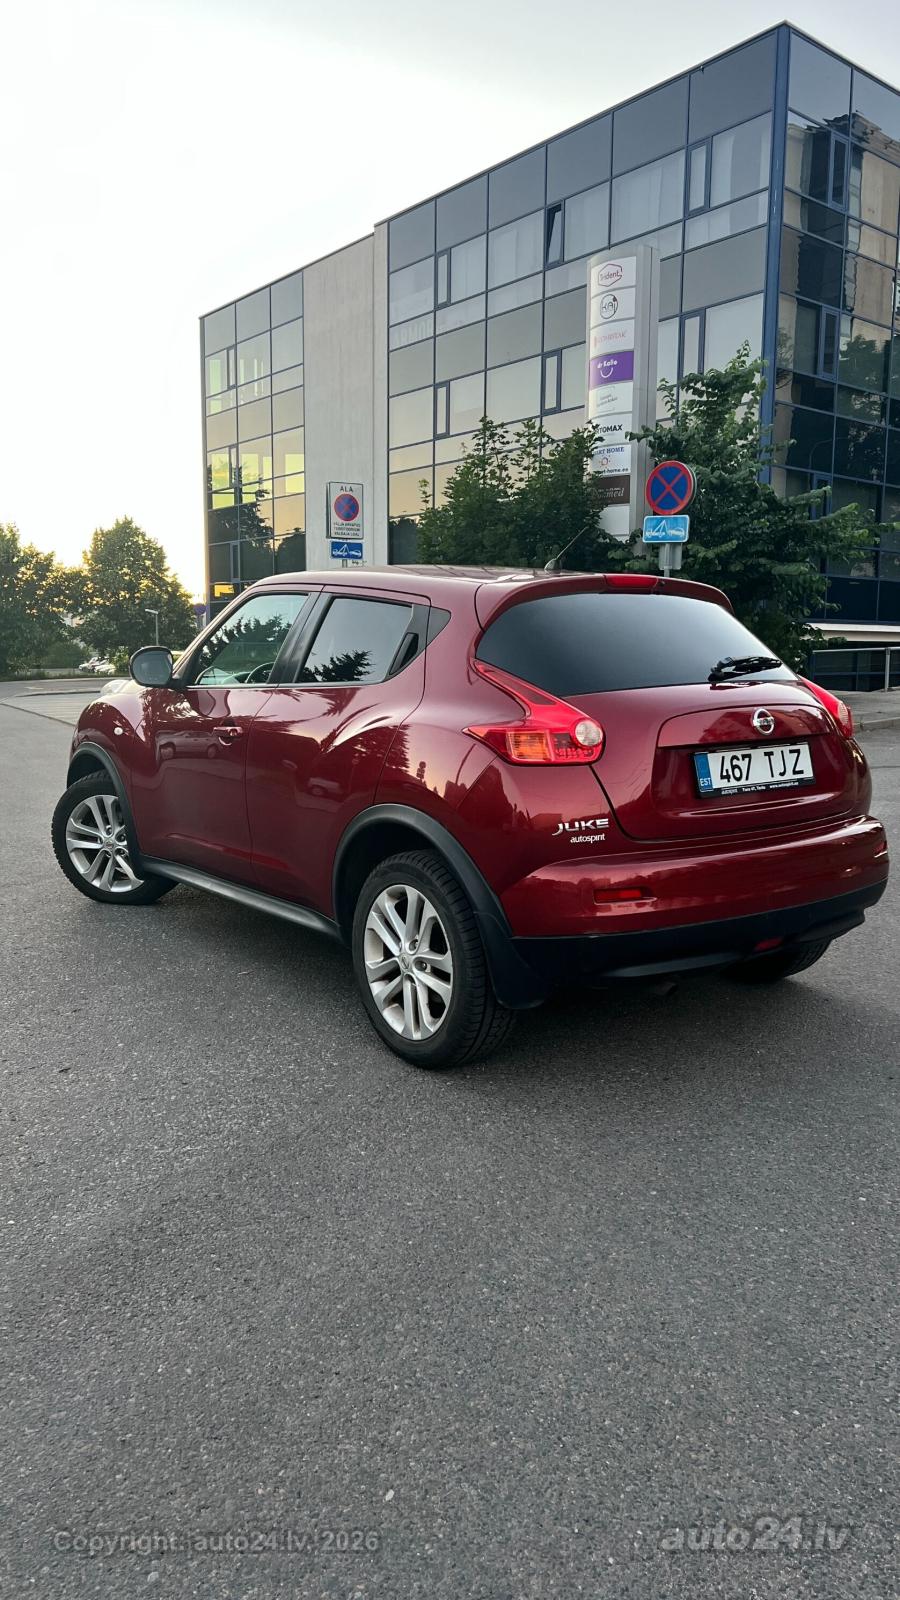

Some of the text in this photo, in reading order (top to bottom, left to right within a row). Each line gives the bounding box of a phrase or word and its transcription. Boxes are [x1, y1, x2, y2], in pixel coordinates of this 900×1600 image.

[720, 749, 804, 782] 467 TJZ
[700, 778, 711, 786] EST
[552, 818, 609, 835] JUKE
[570, 833, 605, 843] autospirit
